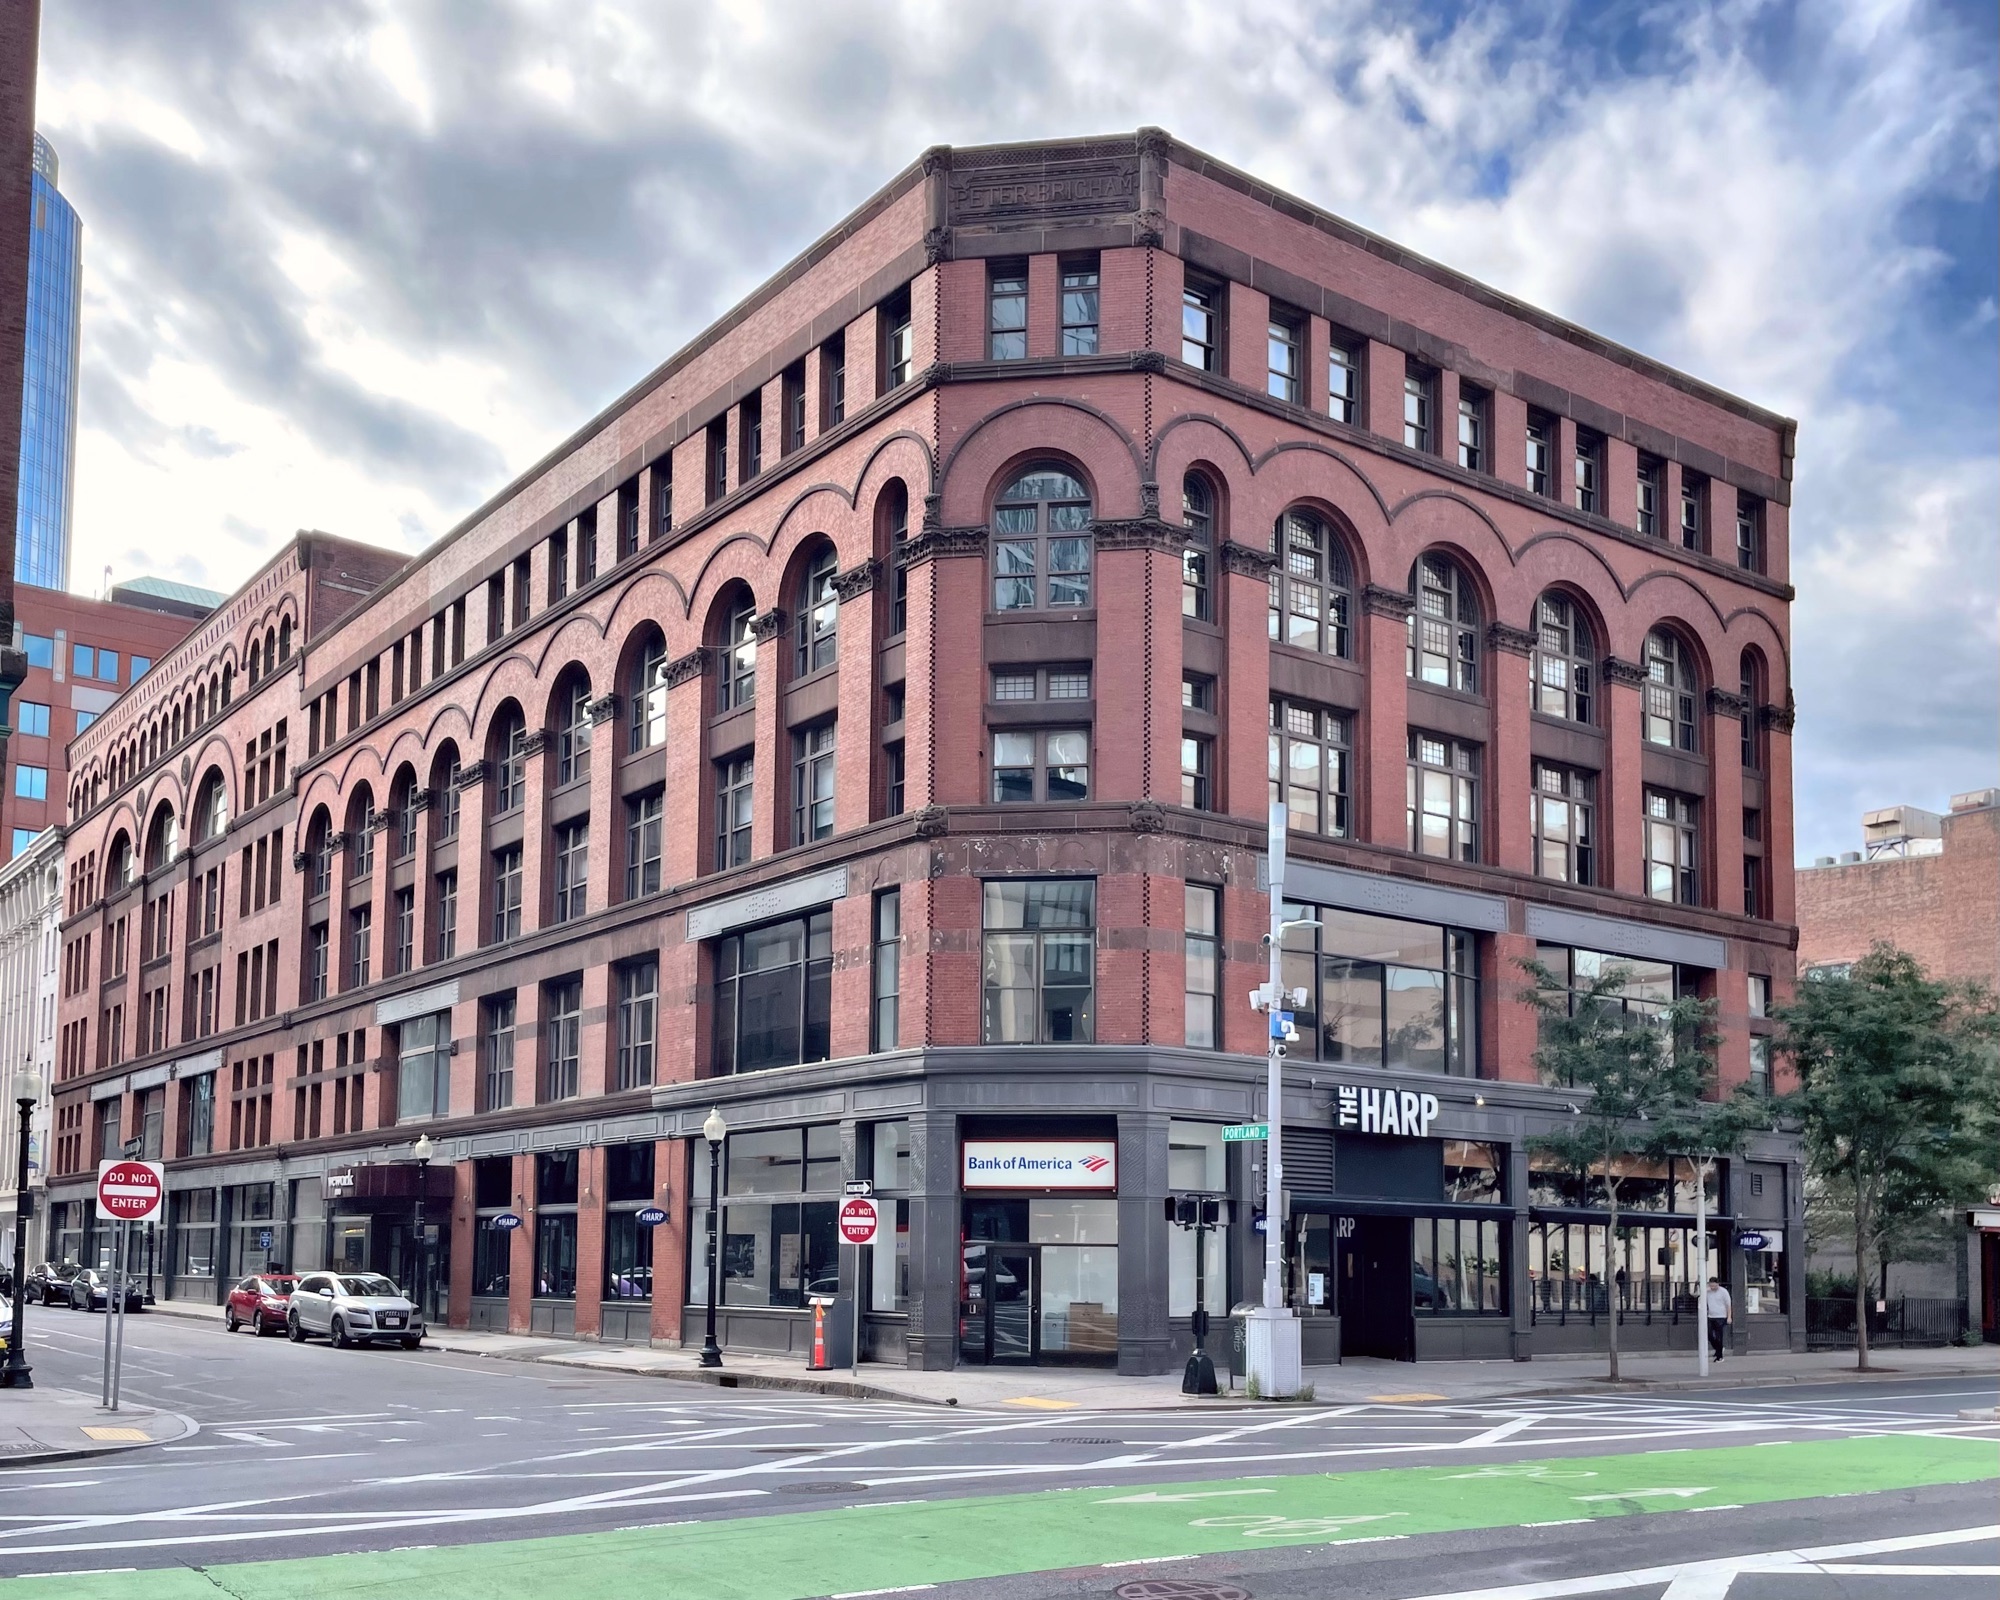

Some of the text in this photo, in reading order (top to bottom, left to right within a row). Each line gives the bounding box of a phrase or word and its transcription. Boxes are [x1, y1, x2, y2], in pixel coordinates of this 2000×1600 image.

[1339, 1085, 1439, 1137] THE HARP
[1224, 1126, 1260, 1139] PORTLAND
[968, 1156, 1072, 1169] Bank of America
[109, 1172, 153, 1183] DO NOT
[111, 1198, 147, 1208] ENTER
[645, 1212, 664, 1221] HARP
[845, 1207, 872, 1216] DO NOT
[501, 1218, 518, 1226] HARP
[847, 1227, 869, 1235] ENTER
[1336, 1217, 1356, 1238] RP
[1743, 1237, 1761, 1246] HARP
